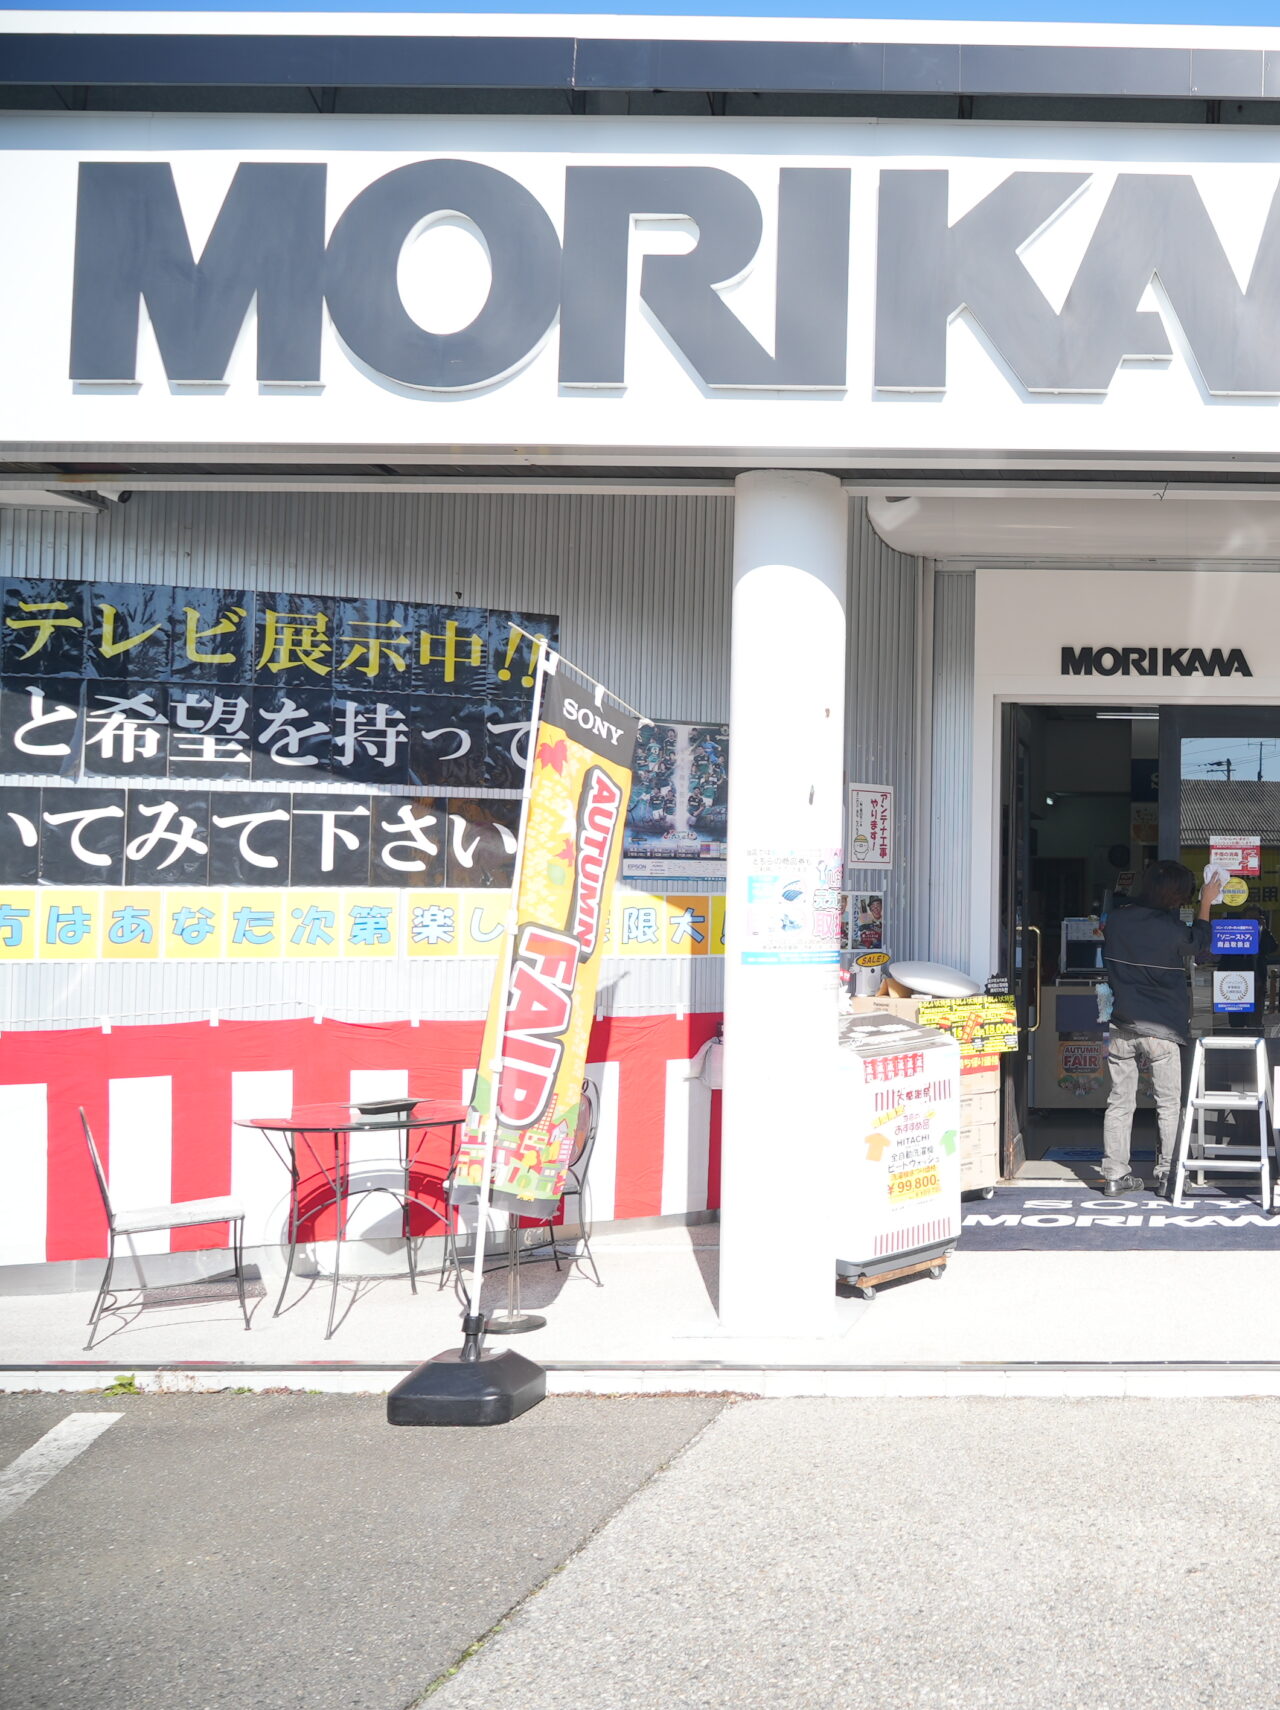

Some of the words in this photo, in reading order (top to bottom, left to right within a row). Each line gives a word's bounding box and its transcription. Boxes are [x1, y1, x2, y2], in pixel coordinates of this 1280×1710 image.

[1061, 646, 1254, 678] MORIKAWA
[13, 685, 538, 768] と希望を持って
[561, 696, 626, 748] SONY
[576, 766, 622, 954] AUTUMN
[861, 955, 886, 965] SALE!
[1063, 1055, 1098, 1067] FAIR
[1064, 1046, 1099, 1054] AUTUMN
[896, 1134, 930, 1147] HITACHI
